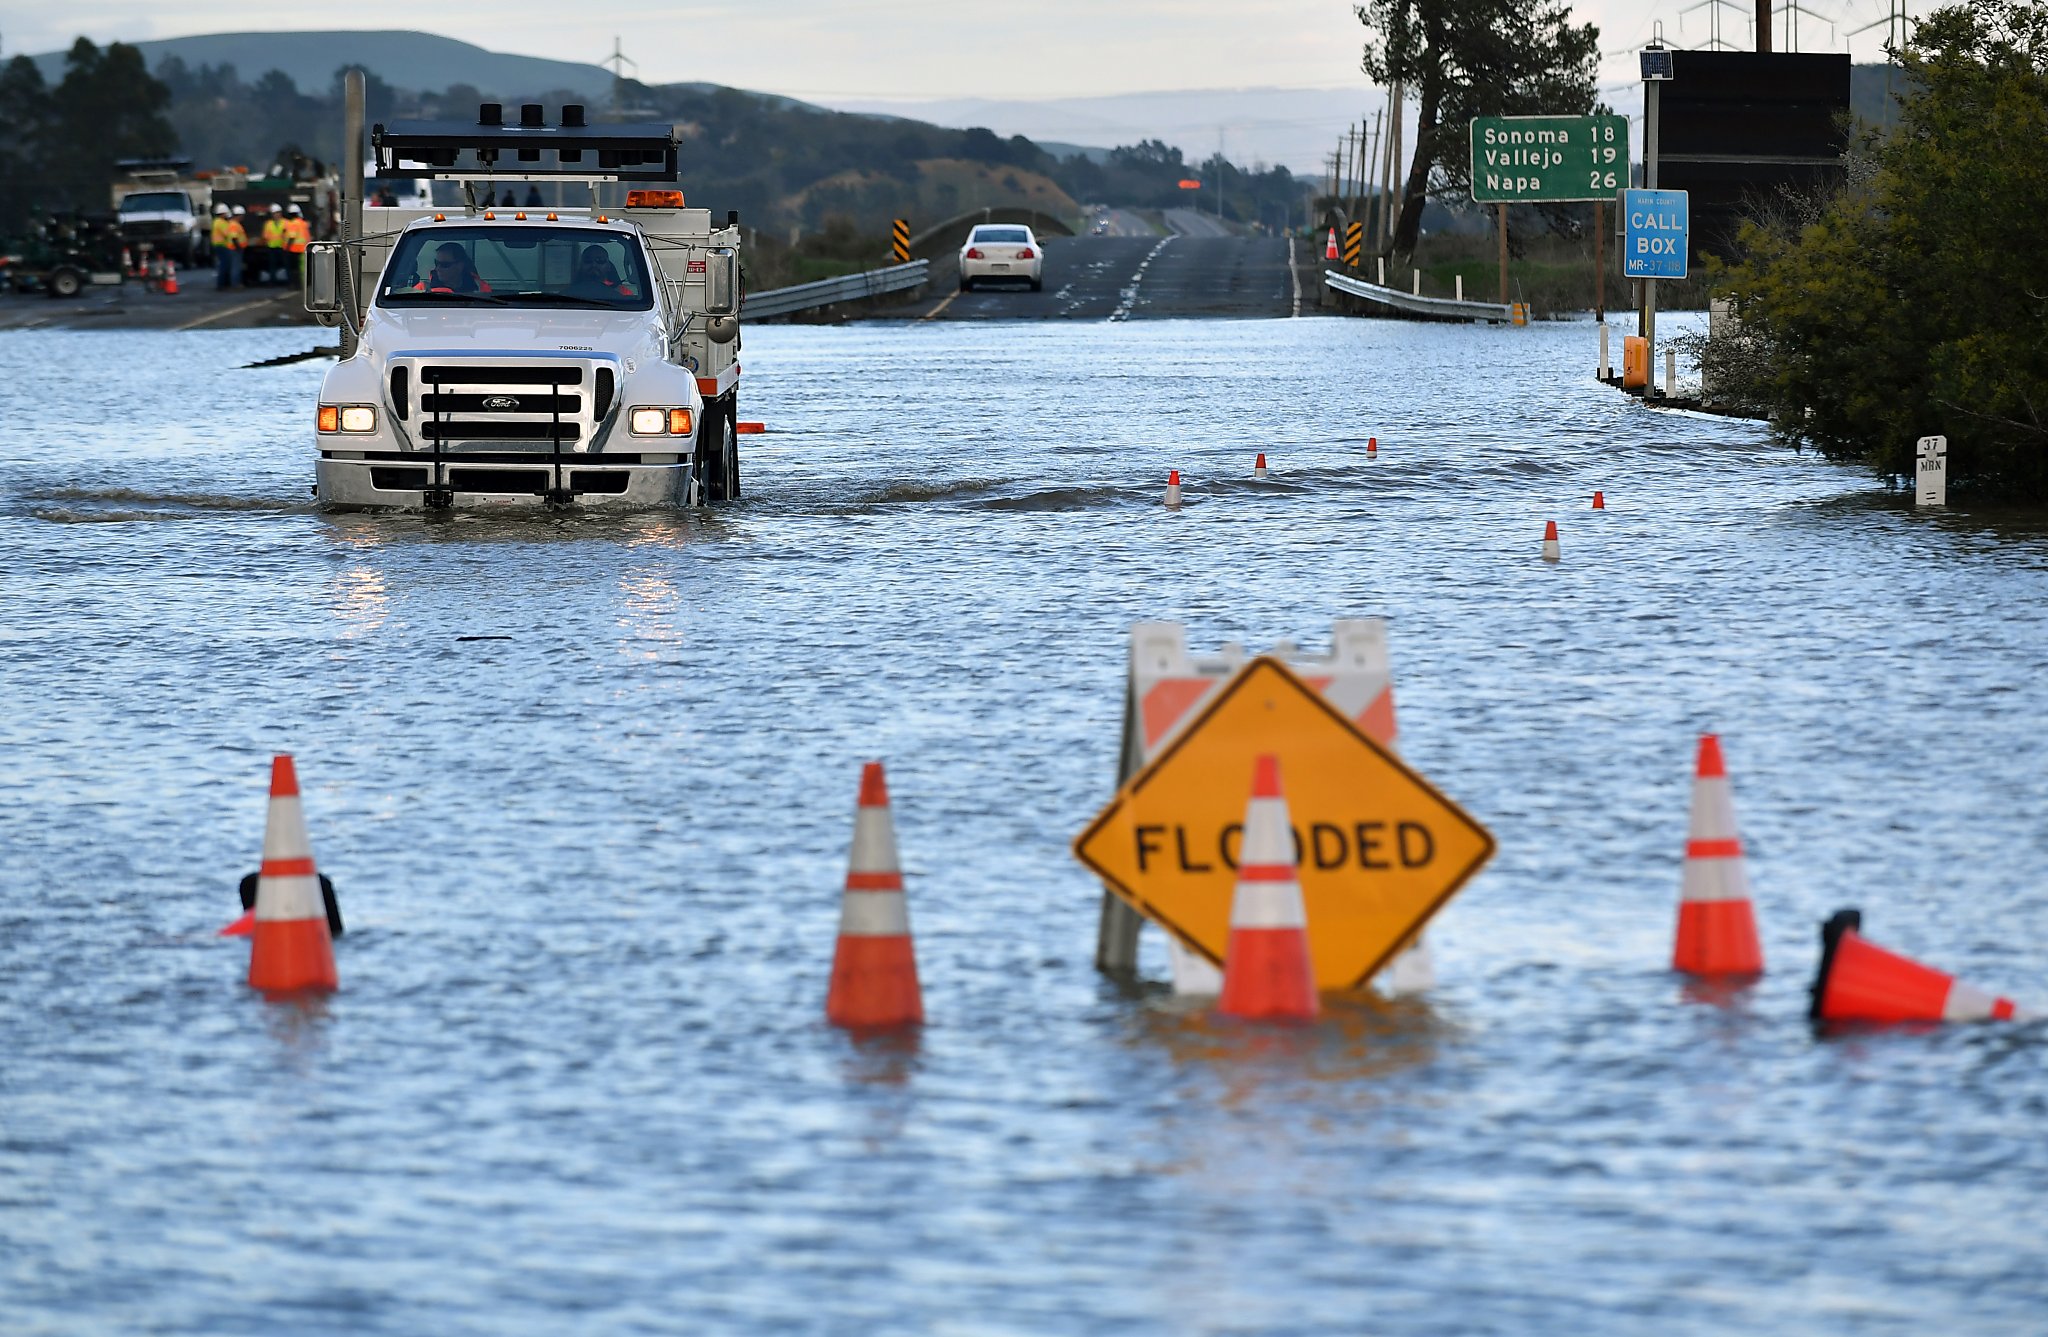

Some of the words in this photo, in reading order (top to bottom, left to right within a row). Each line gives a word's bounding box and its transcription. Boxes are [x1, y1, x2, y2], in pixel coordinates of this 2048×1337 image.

[1484, 127, 1569, 145] Sonoma
[1590, 126, 1615, 143] 18
[1484, 147, 1563, 170] Vallejo
[1591, 147, 1617, 165] 19
[1486, 173, 1541, 195] Napa
[1590, 170, 1617, 190] 26
[1631, 211, 1683, 231] CALL
[1637, 237, 1676, 255] BOX
[1923, 438, 1938, 451] 37
[1920, 460, 1942, 472] MRN
[1134, 820, 1436, 874] FLODED
